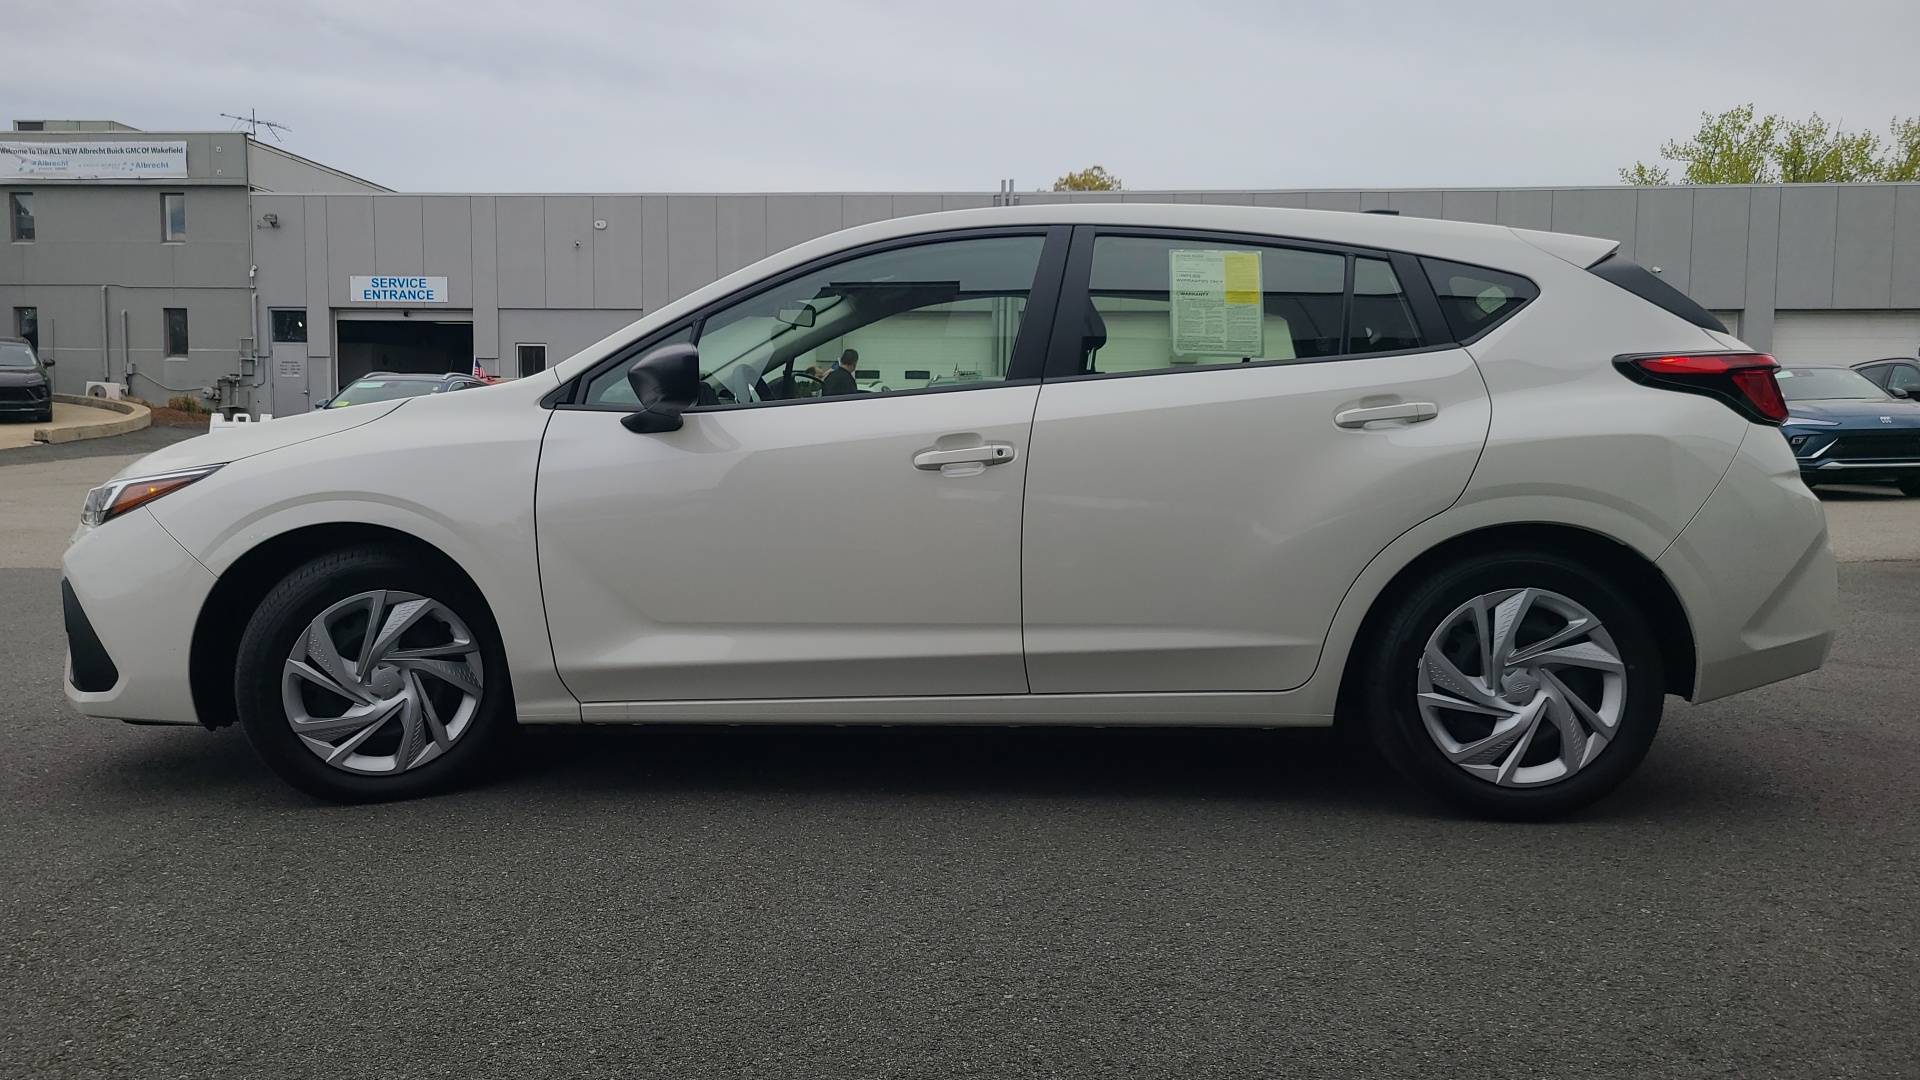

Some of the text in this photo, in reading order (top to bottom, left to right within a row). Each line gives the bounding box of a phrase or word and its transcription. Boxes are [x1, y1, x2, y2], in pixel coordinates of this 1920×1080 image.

[0, 147, 28, 155] Welcome
[49, 147, 61, 155] ALL
[62, 147, 78, 155] NEW
[79, 147, 106, 155] Albrecht
[106, 147, 125, 155] Buick
[125, 147, 141, 155] GMC
[141, 147, 150, 155] Of
[135, 161, 170, 169] Albrecht
[371, 277, 427, 288] SERVICE
[363, 289, 434, 300] ENTRANCE
